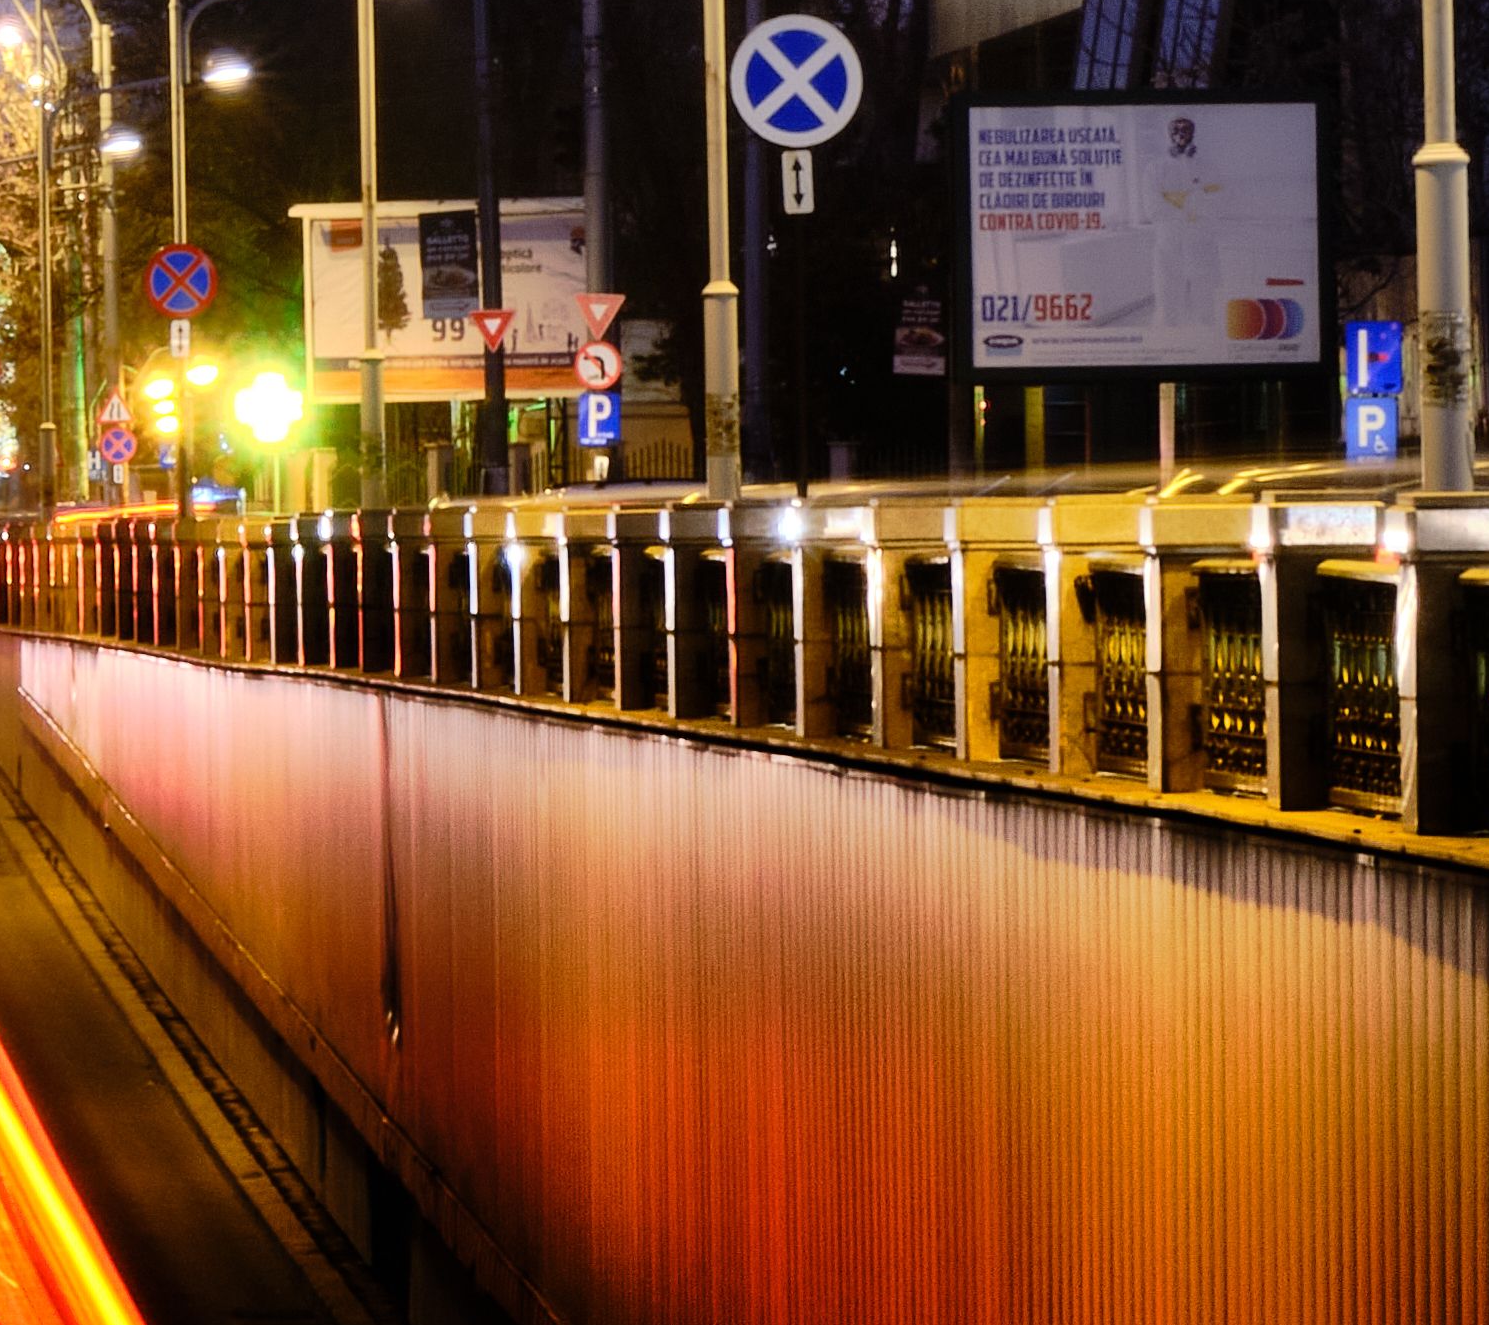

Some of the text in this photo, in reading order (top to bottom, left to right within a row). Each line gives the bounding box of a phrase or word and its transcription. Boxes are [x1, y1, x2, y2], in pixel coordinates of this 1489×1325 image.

[978, 127, 1065, 145] NEBULIZAREA
[978, 150, 1002, 167] CEA
[1005, 150, 1029, 167] MAI
[978, 171, 995, 188] DE
[1032, 192, 1049, 208] DE
[1051, 192, 1105, 209] BIROURI
[979, 212, 1033, 231] CONTRA
[980, 292, 1094, 323] 021/9662
[588, 394, 612, 438] P
[1358, 405, 1386, 448] P
